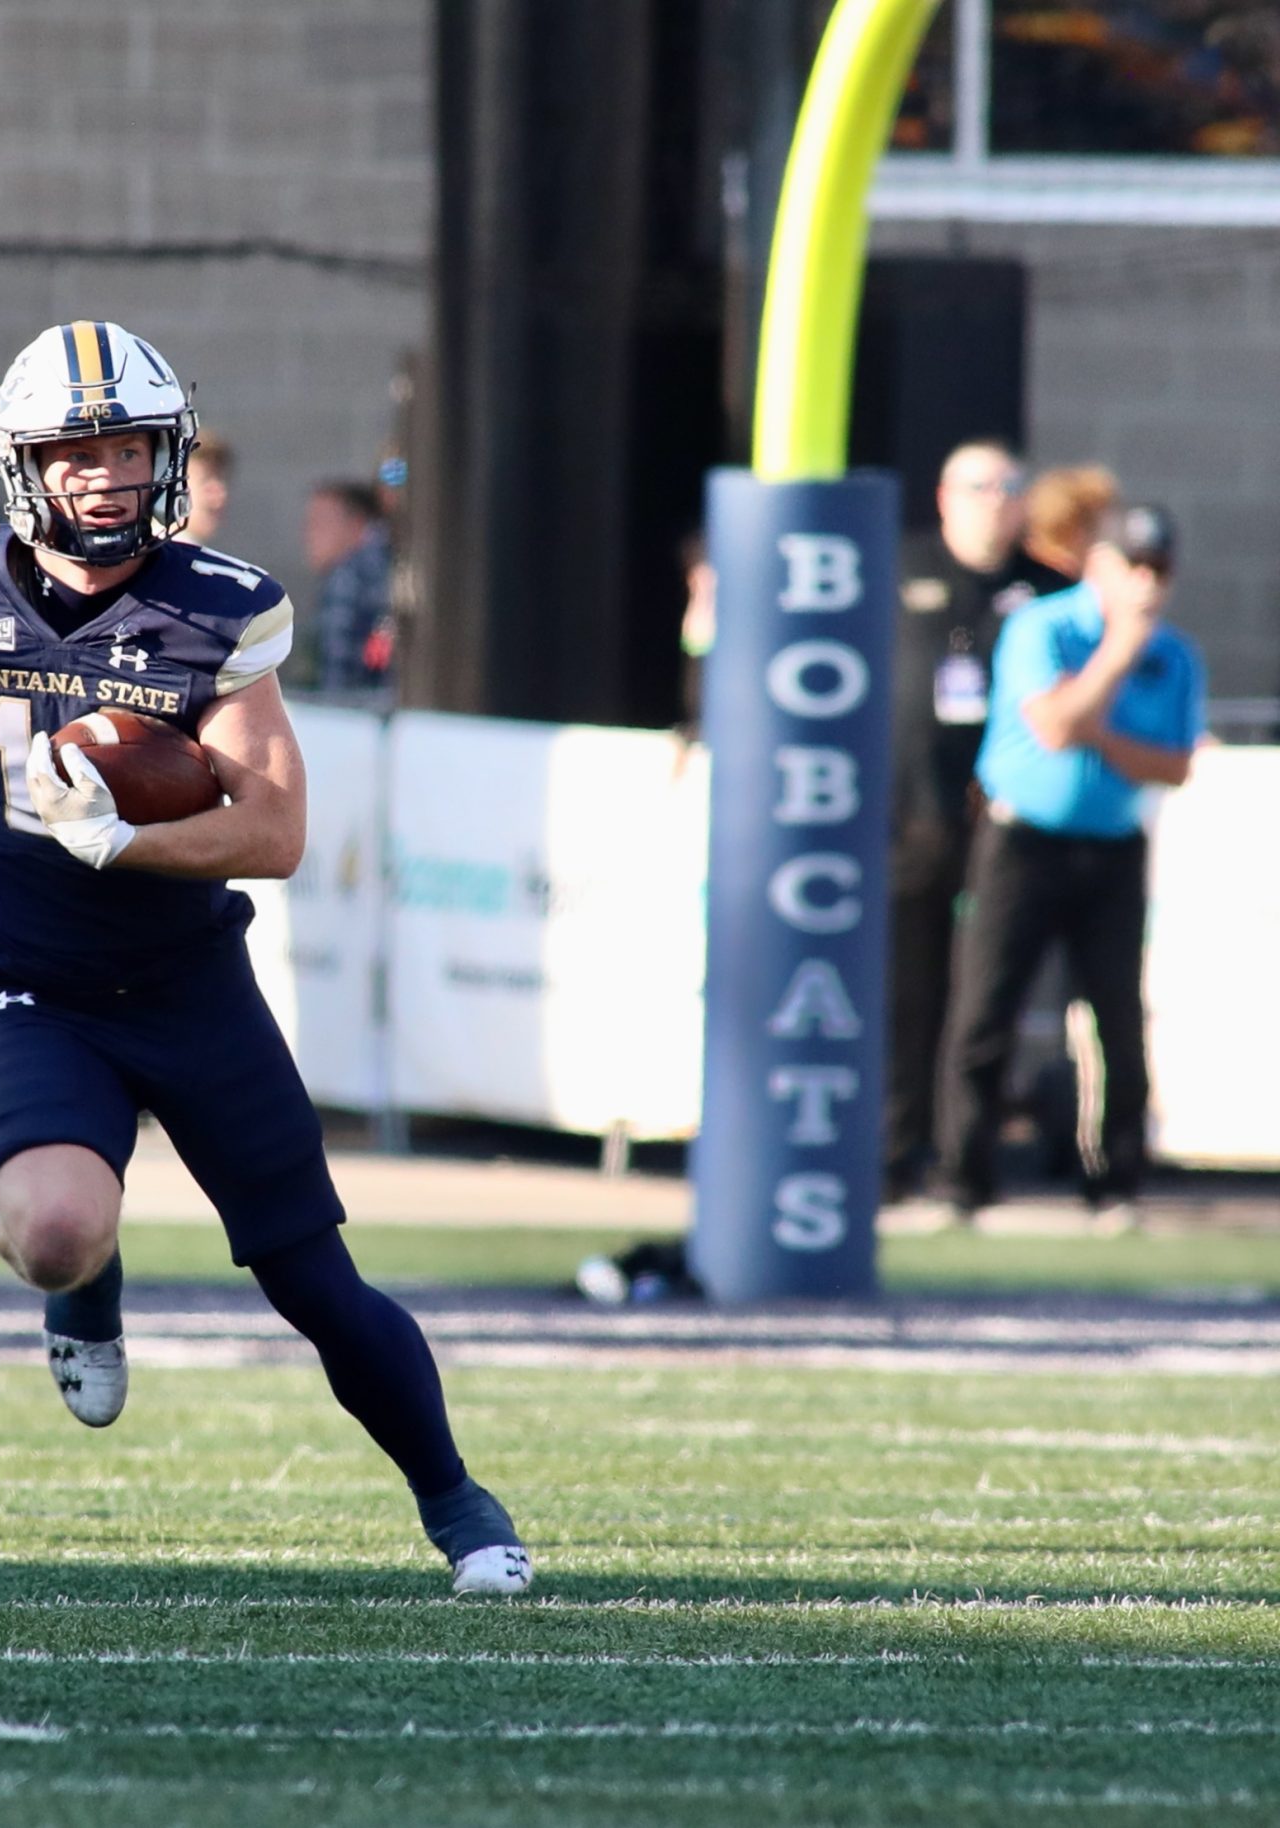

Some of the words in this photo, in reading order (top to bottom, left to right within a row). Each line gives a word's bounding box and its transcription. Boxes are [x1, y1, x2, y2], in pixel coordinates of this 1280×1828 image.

[78, 404, 112, 421] 406
[96, 679, 180, 715] STATE
[766, 532, 870, 1252] BOBCATS
